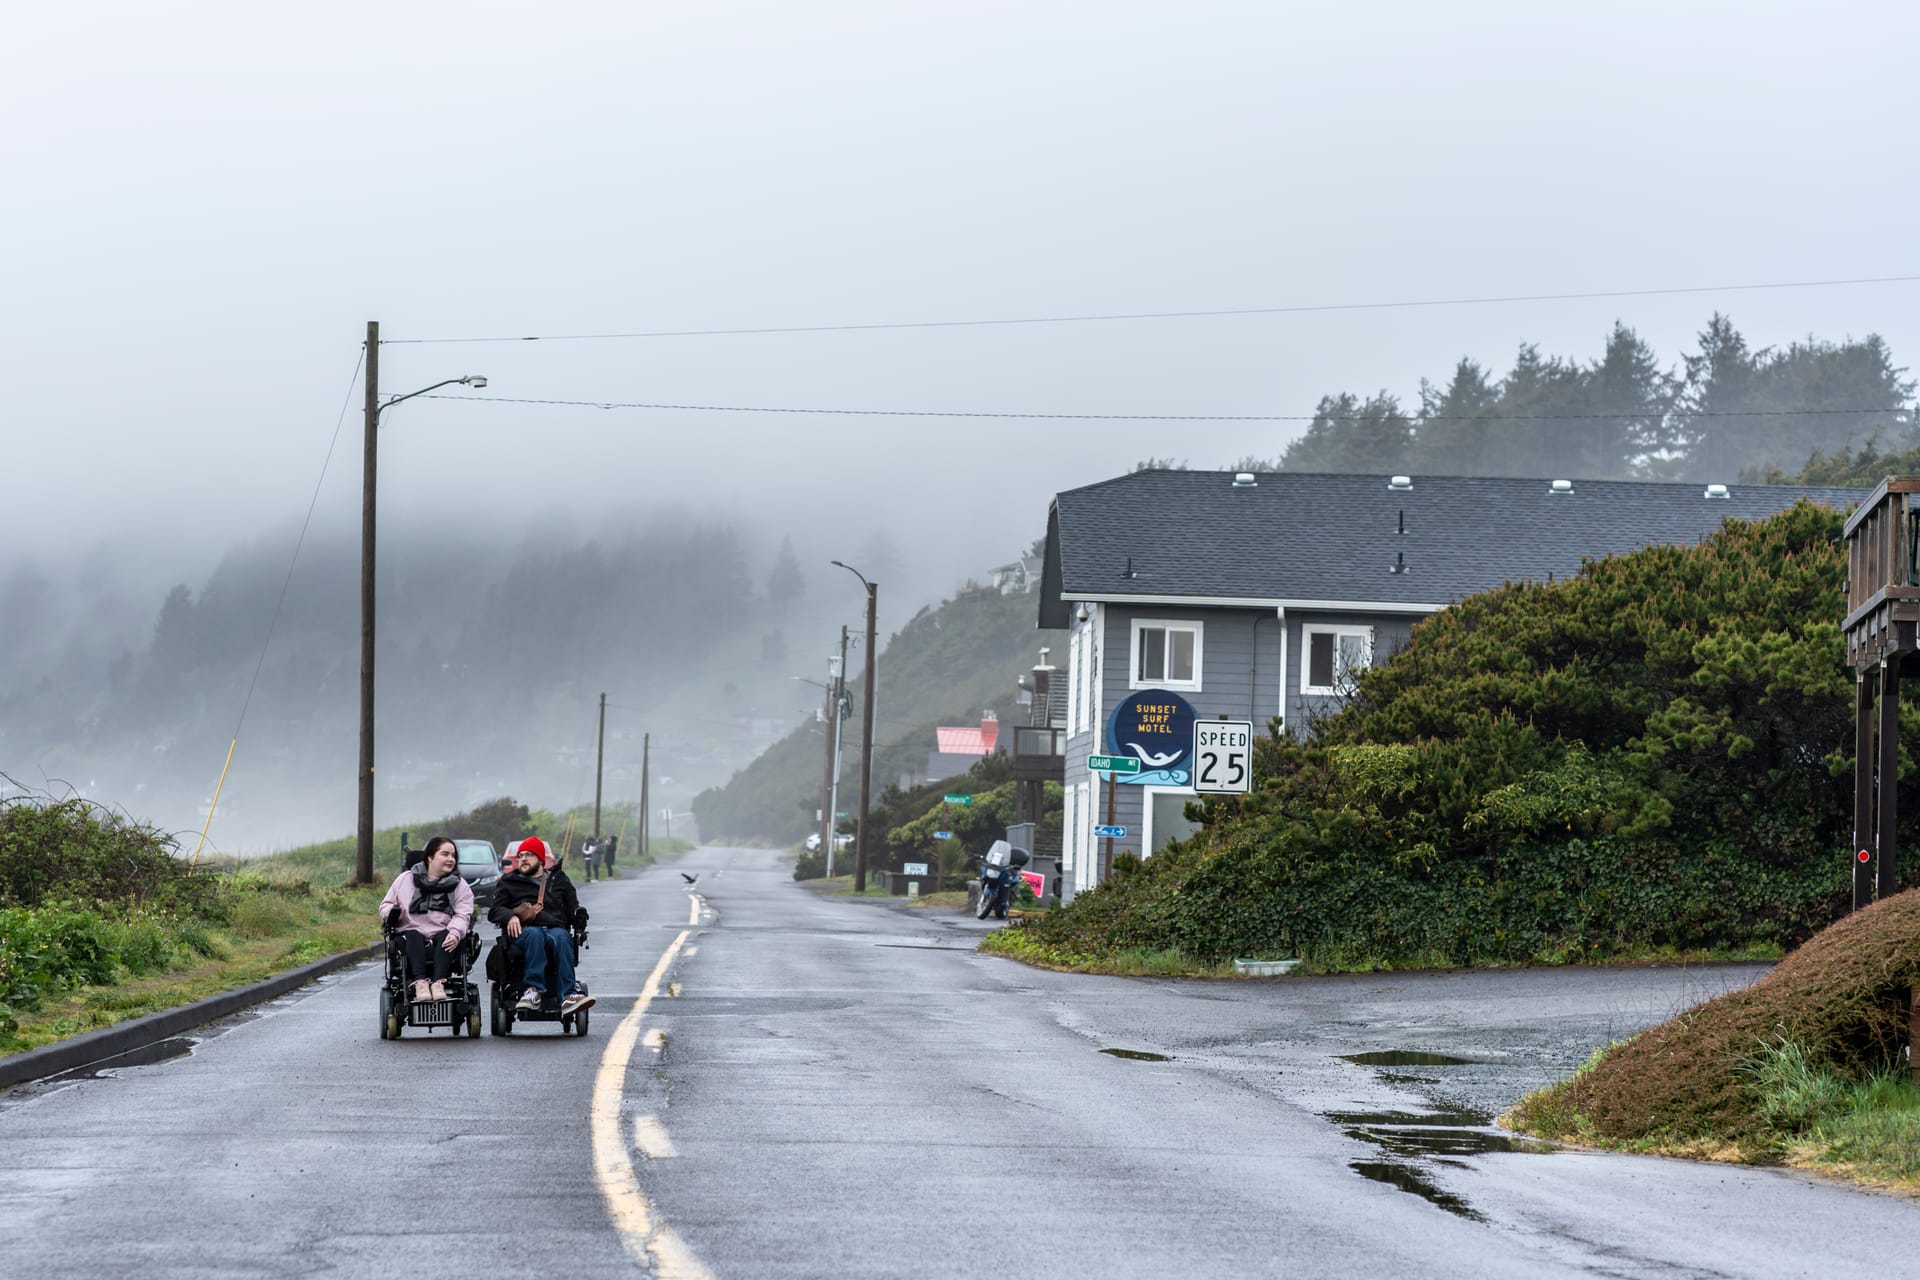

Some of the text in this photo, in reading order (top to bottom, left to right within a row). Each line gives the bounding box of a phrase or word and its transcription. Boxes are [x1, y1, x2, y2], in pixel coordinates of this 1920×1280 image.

[1136, 704, 1177, 714] SUNSET
[1142, 714, 1169, 723] SURF
[1138, 724, 1172, 733] MOTEL
[1200, 731, 1247, 746] SPEED
[1090, 757, 1111, 769] IDAHO
[1200, 752, 1244, 784] 25
